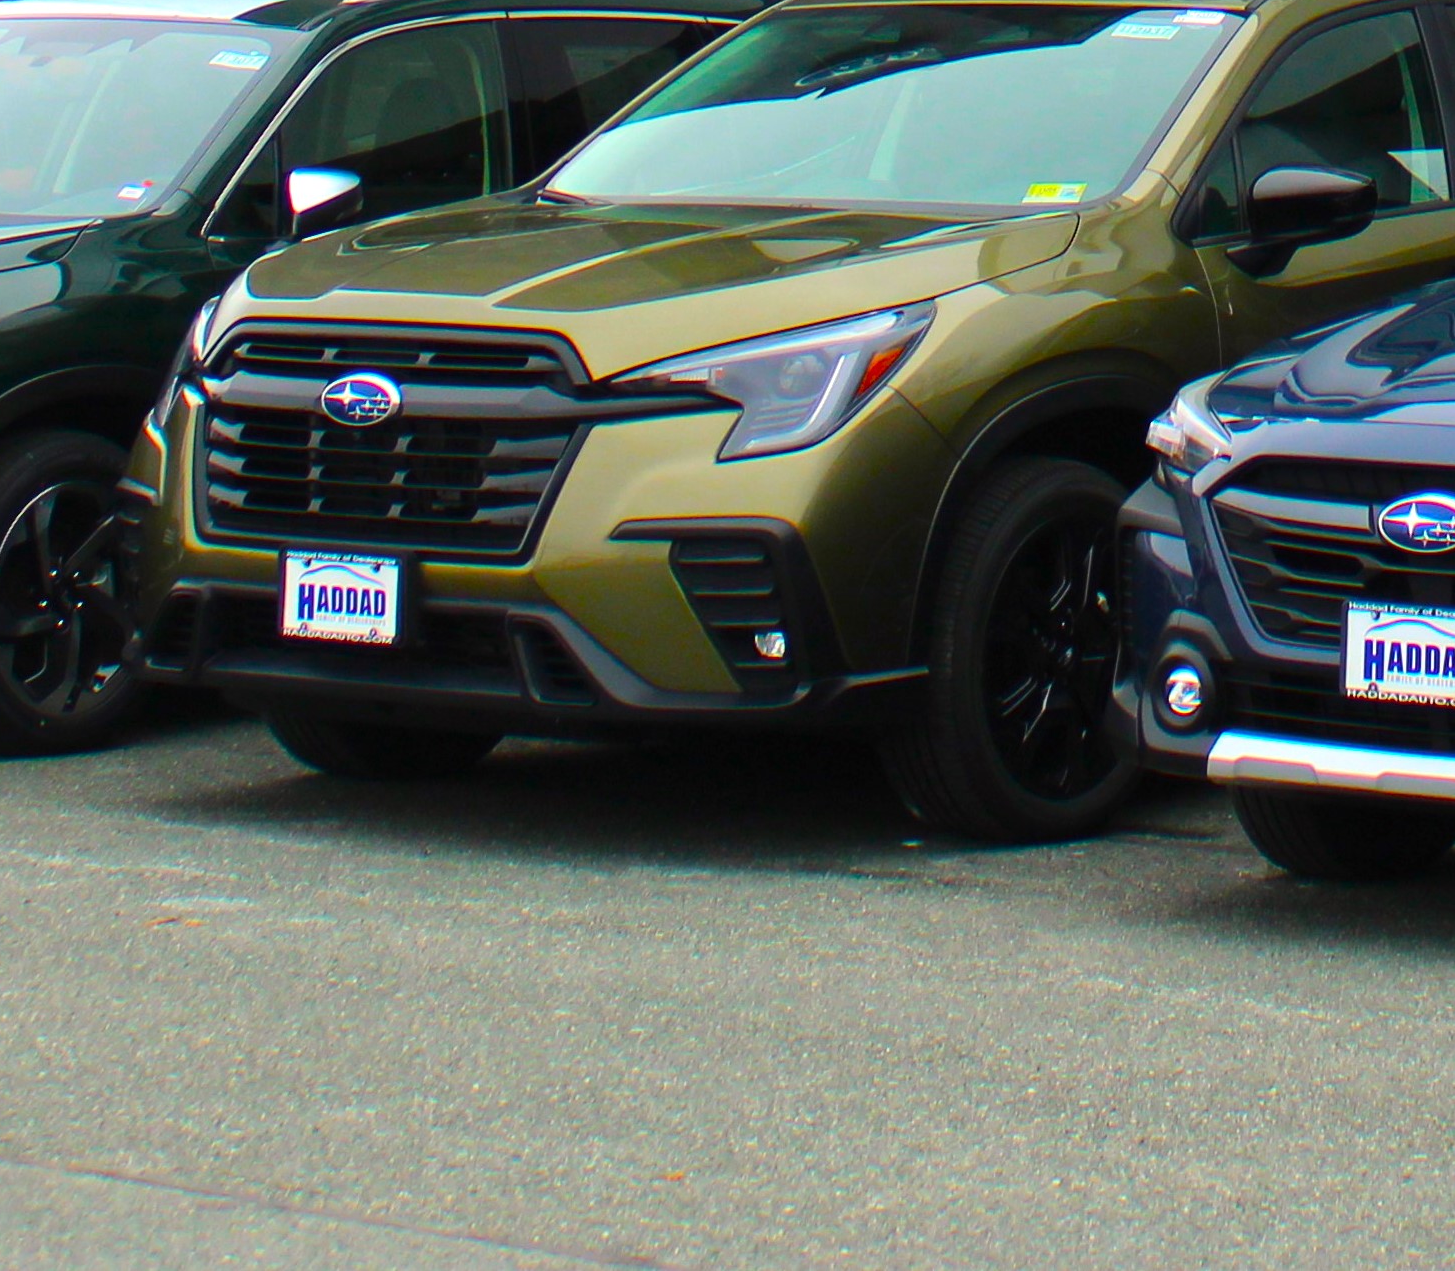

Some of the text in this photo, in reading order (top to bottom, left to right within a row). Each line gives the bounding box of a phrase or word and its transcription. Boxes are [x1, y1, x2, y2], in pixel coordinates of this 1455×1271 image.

[298, 583, 387, 621] HADDAD
[1348, 601, 1388, 612] Haddad
[1390, 604, 1420, 616] Family
